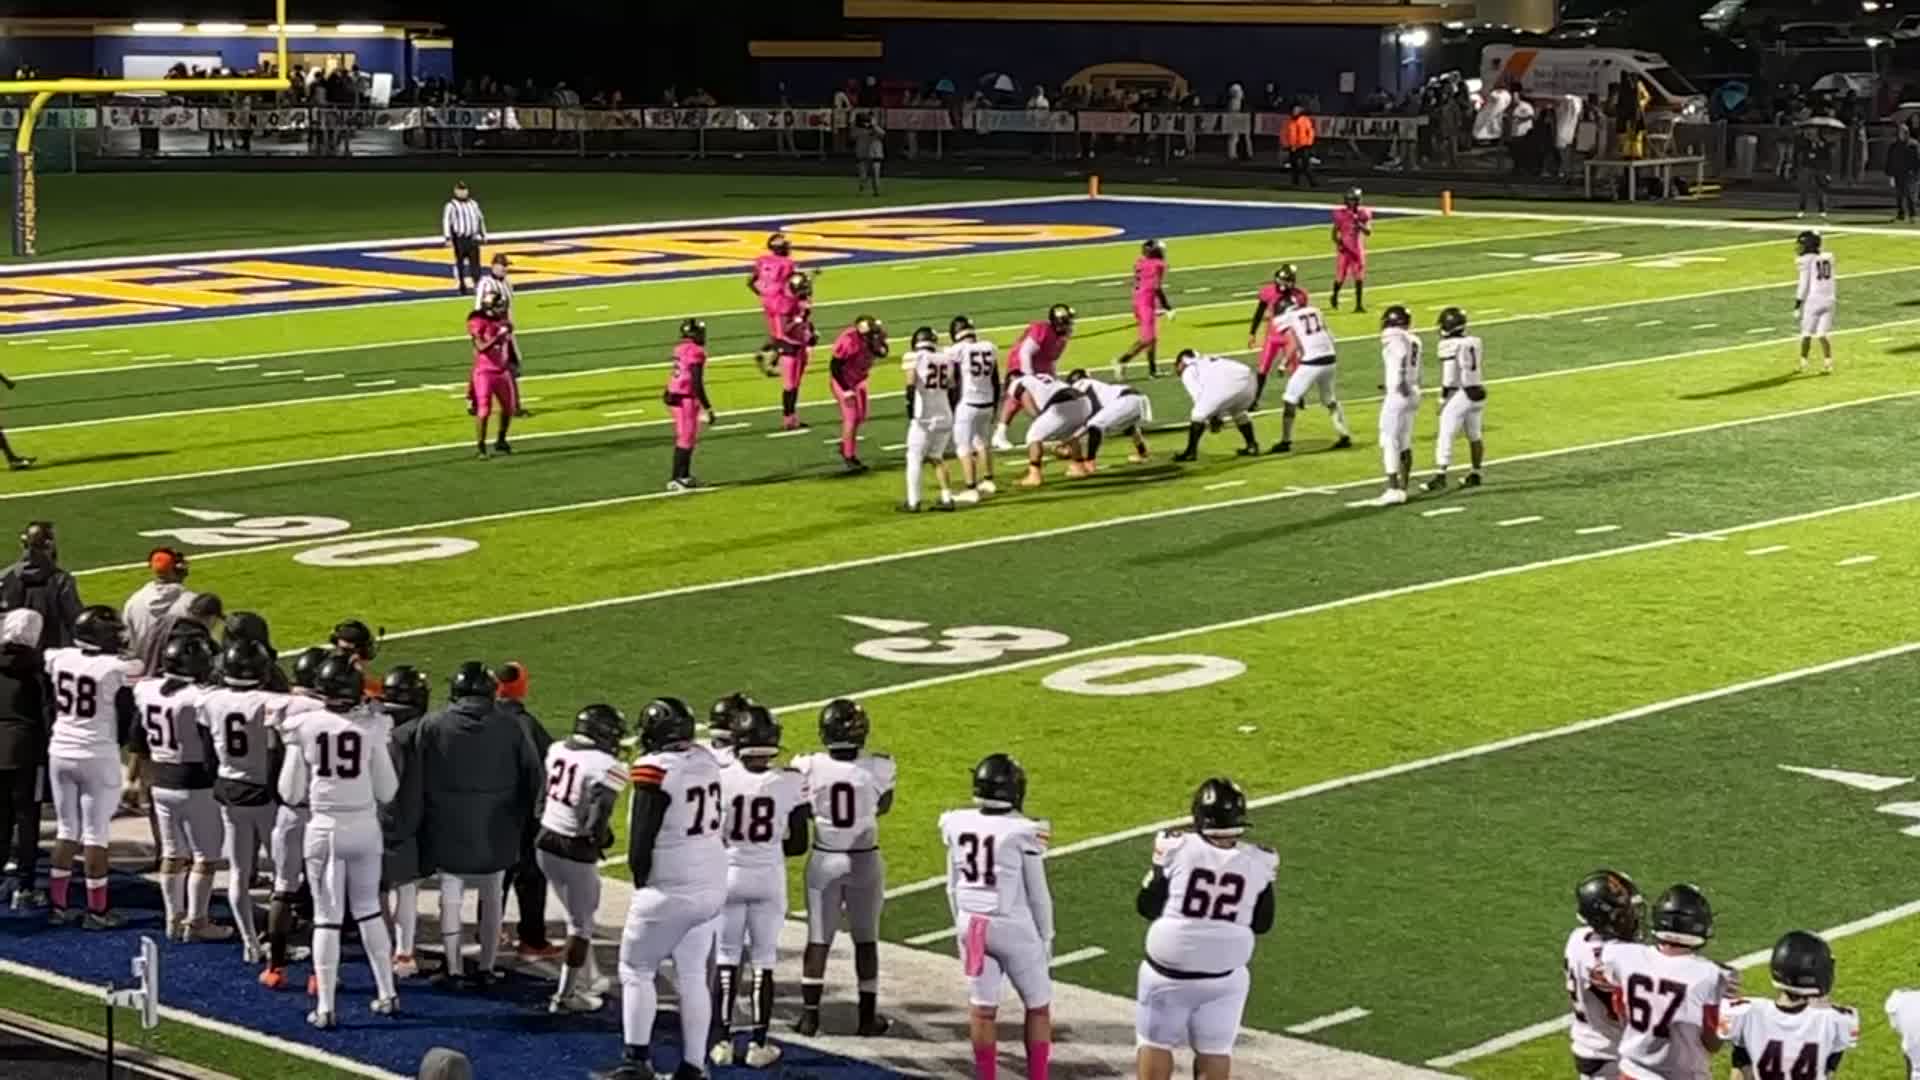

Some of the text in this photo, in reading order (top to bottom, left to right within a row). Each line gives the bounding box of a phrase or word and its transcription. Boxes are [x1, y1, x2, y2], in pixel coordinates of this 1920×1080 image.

[1816, 260, 1831, 280] 10
[1298, 312, 1321, 335] 77
[925, 362, 948, 388] 26
[970, 351, 992, 376] 55
[56, 671, 97, 718] 58
[146, 704, 179, 750] 51
[224, 712, 249, 757] 6
[315, 731, 361, 778] 19
[547, 758, 579, 807] 21
[830, 781, 856, 828] 0
[730, 794, 775, 843] 18
[958, 832, 997, 887] 31
[1182, 867, 1247, 922] 62
[1627, 973, 1687, 1038] 67
[1757, 1040, 1820, 1080] 44
